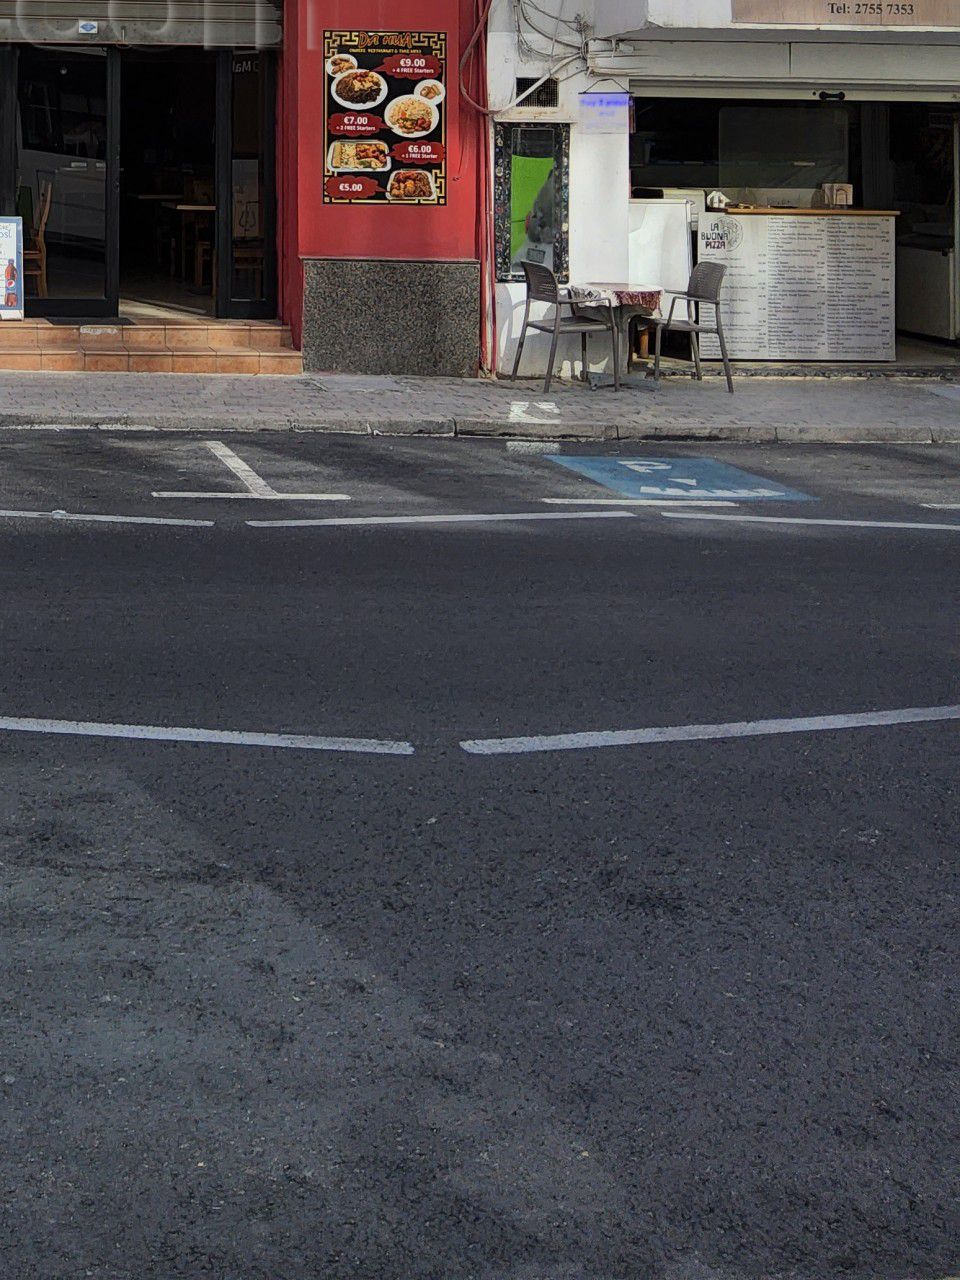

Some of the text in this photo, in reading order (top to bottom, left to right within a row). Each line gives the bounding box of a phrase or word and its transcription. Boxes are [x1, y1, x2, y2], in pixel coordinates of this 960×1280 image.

[827, 2, 914, 15] Tel: 2755 7353
[399, 58, 426, 68] €9.00
[343, 116, 368, 125] €7.00
[408, 145, 432, 153] €6.00
[339, 183, 363, 191] €5.00
[710, 223, 719, 231] LA
[701, 232, 728, 240] BUONA
[705, 241, 725, 249] PIZZA
